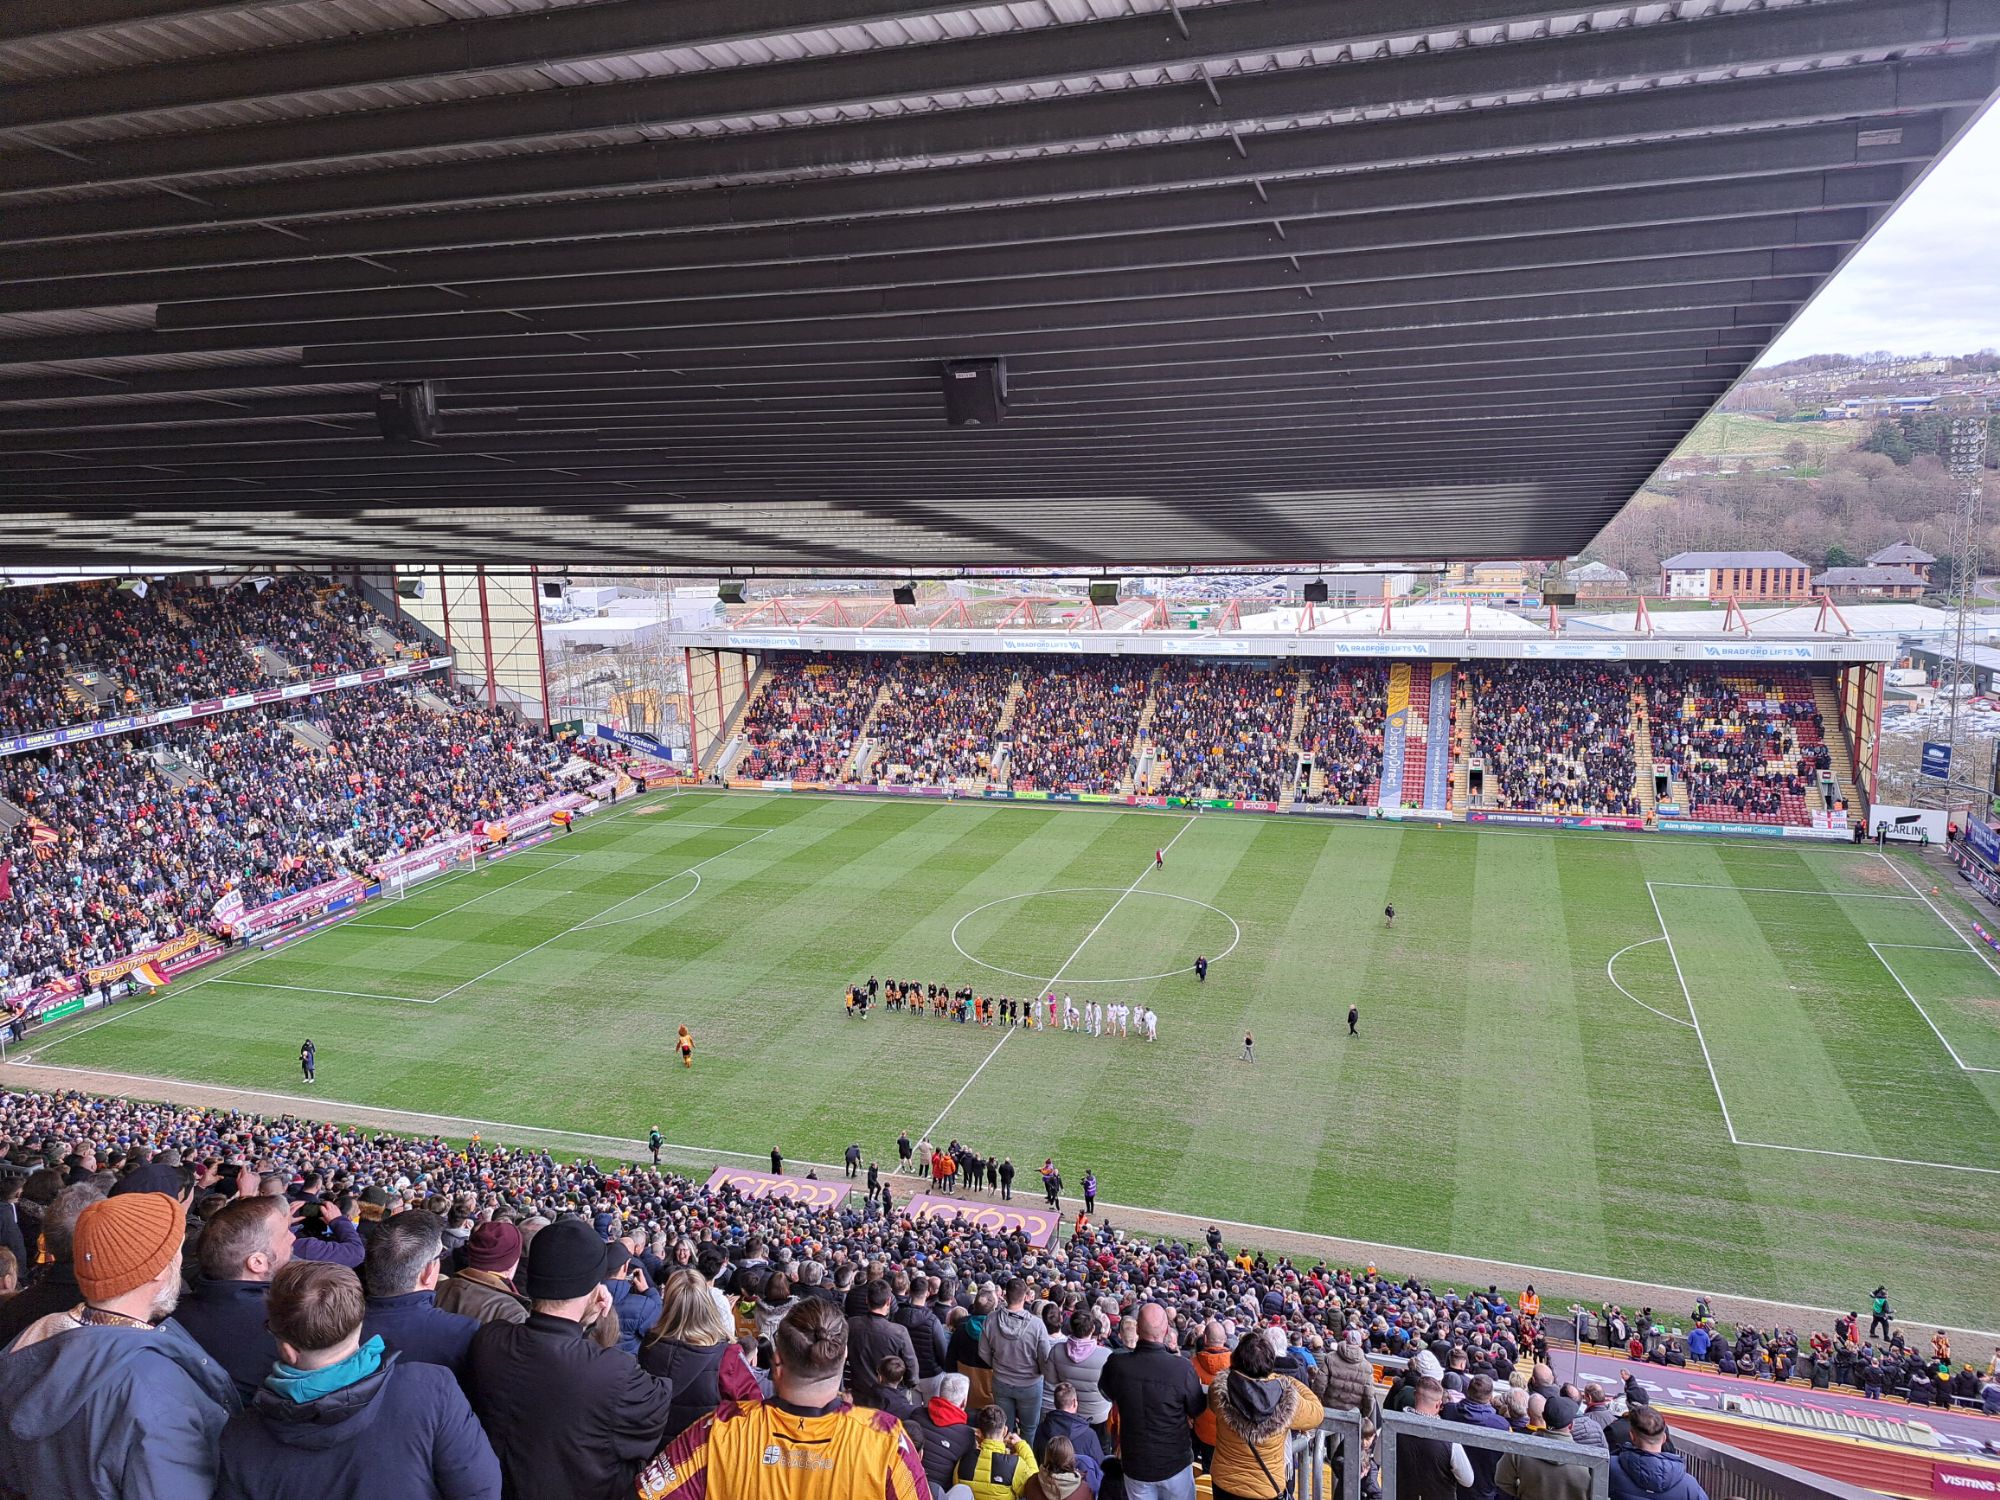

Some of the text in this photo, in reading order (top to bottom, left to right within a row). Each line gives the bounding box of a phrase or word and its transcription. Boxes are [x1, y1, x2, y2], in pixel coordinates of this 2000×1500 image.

[630, 735, 658, 751] Systems
[1680, 824, 1704, 832] Higher
[1721, 826, 1752, 834] Bradford
[1752, 828, 1777, 836] College
[1887, 824, 1928, 836] CARLING
[781, 1457, 833, 1471] BRADFORD
[1939, 1472, 1996, 1492] VISITING
